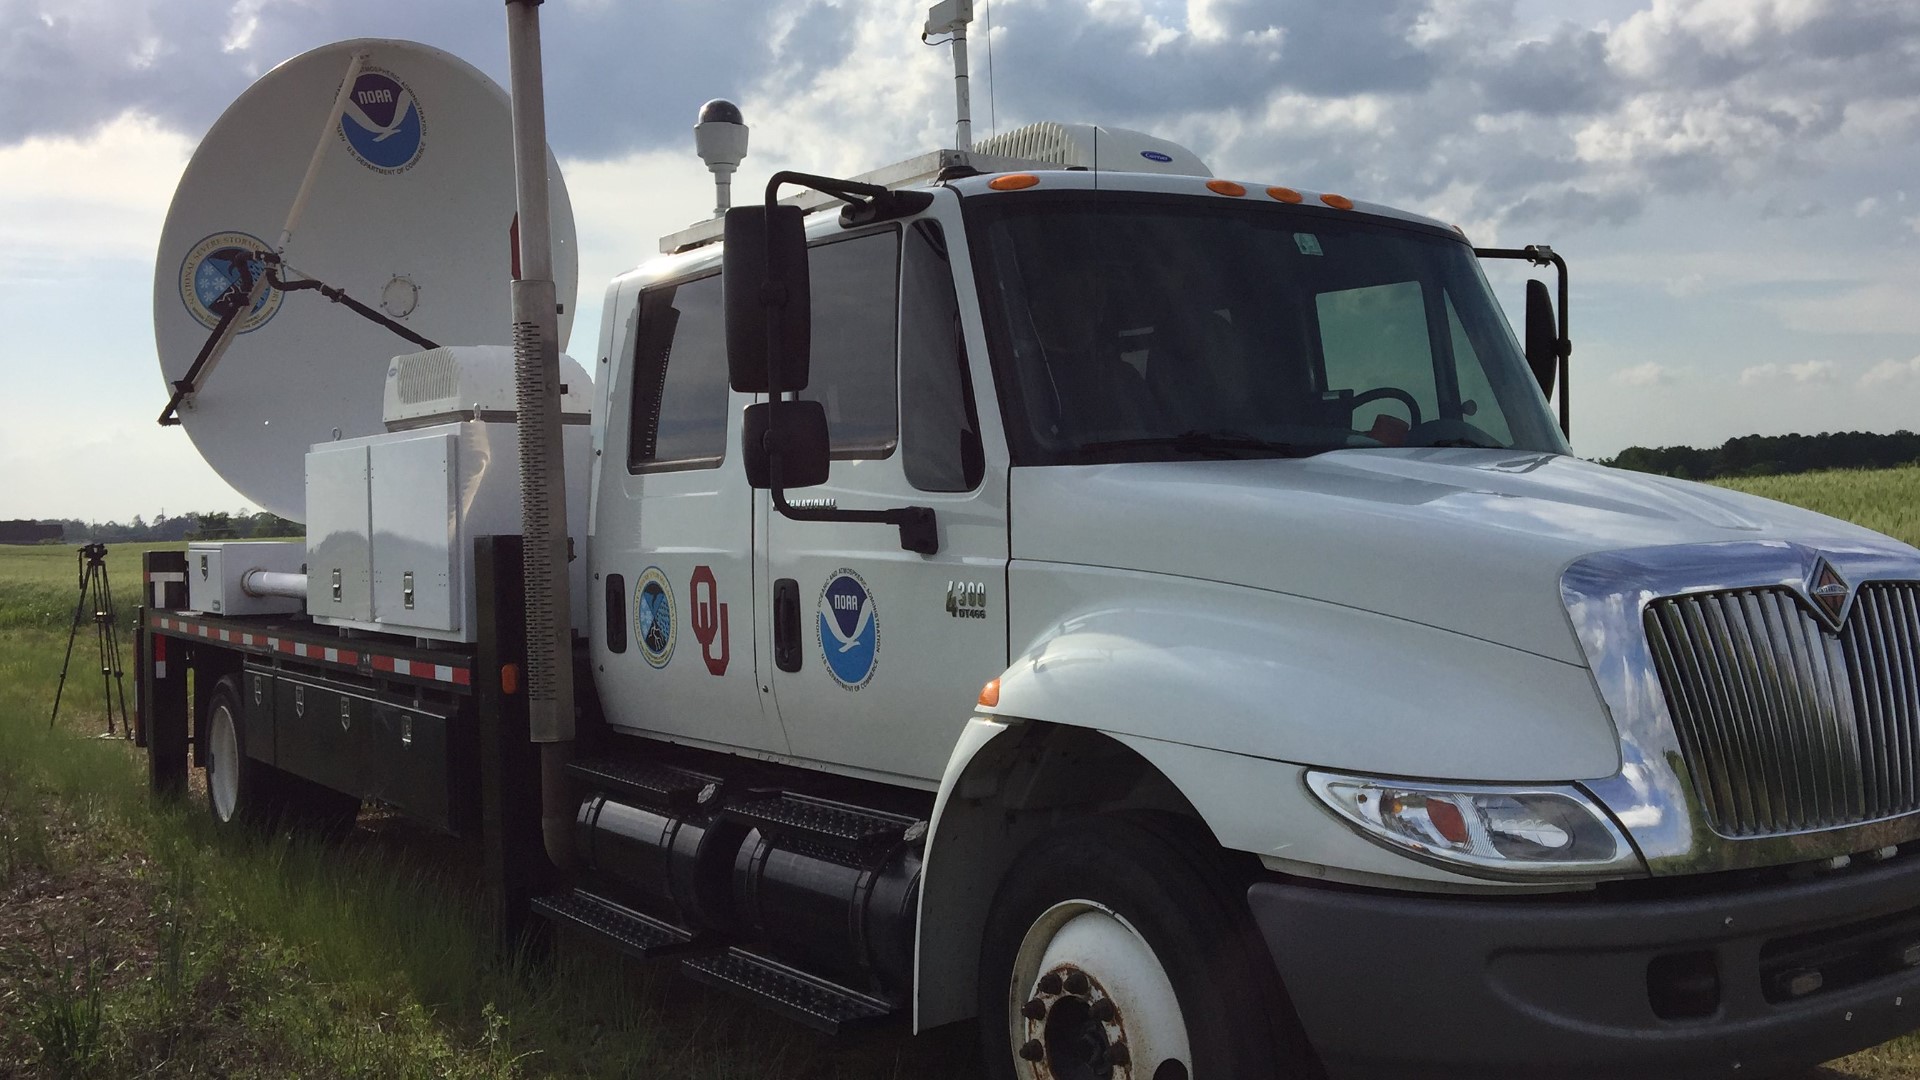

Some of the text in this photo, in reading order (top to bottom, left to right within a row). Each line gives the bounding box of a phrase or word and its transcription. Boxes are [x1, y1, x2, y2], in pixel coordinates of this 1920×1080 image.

[358, 89, 393, 105] NOAA
[356, 156, 395, 175] DEPARTMENT
[834, 594, 858, 610] NOAA
[946, 581, 986, 617] 4300
[690, 566, 730, 676] OU
[959, 609, 986, 619] DT466
